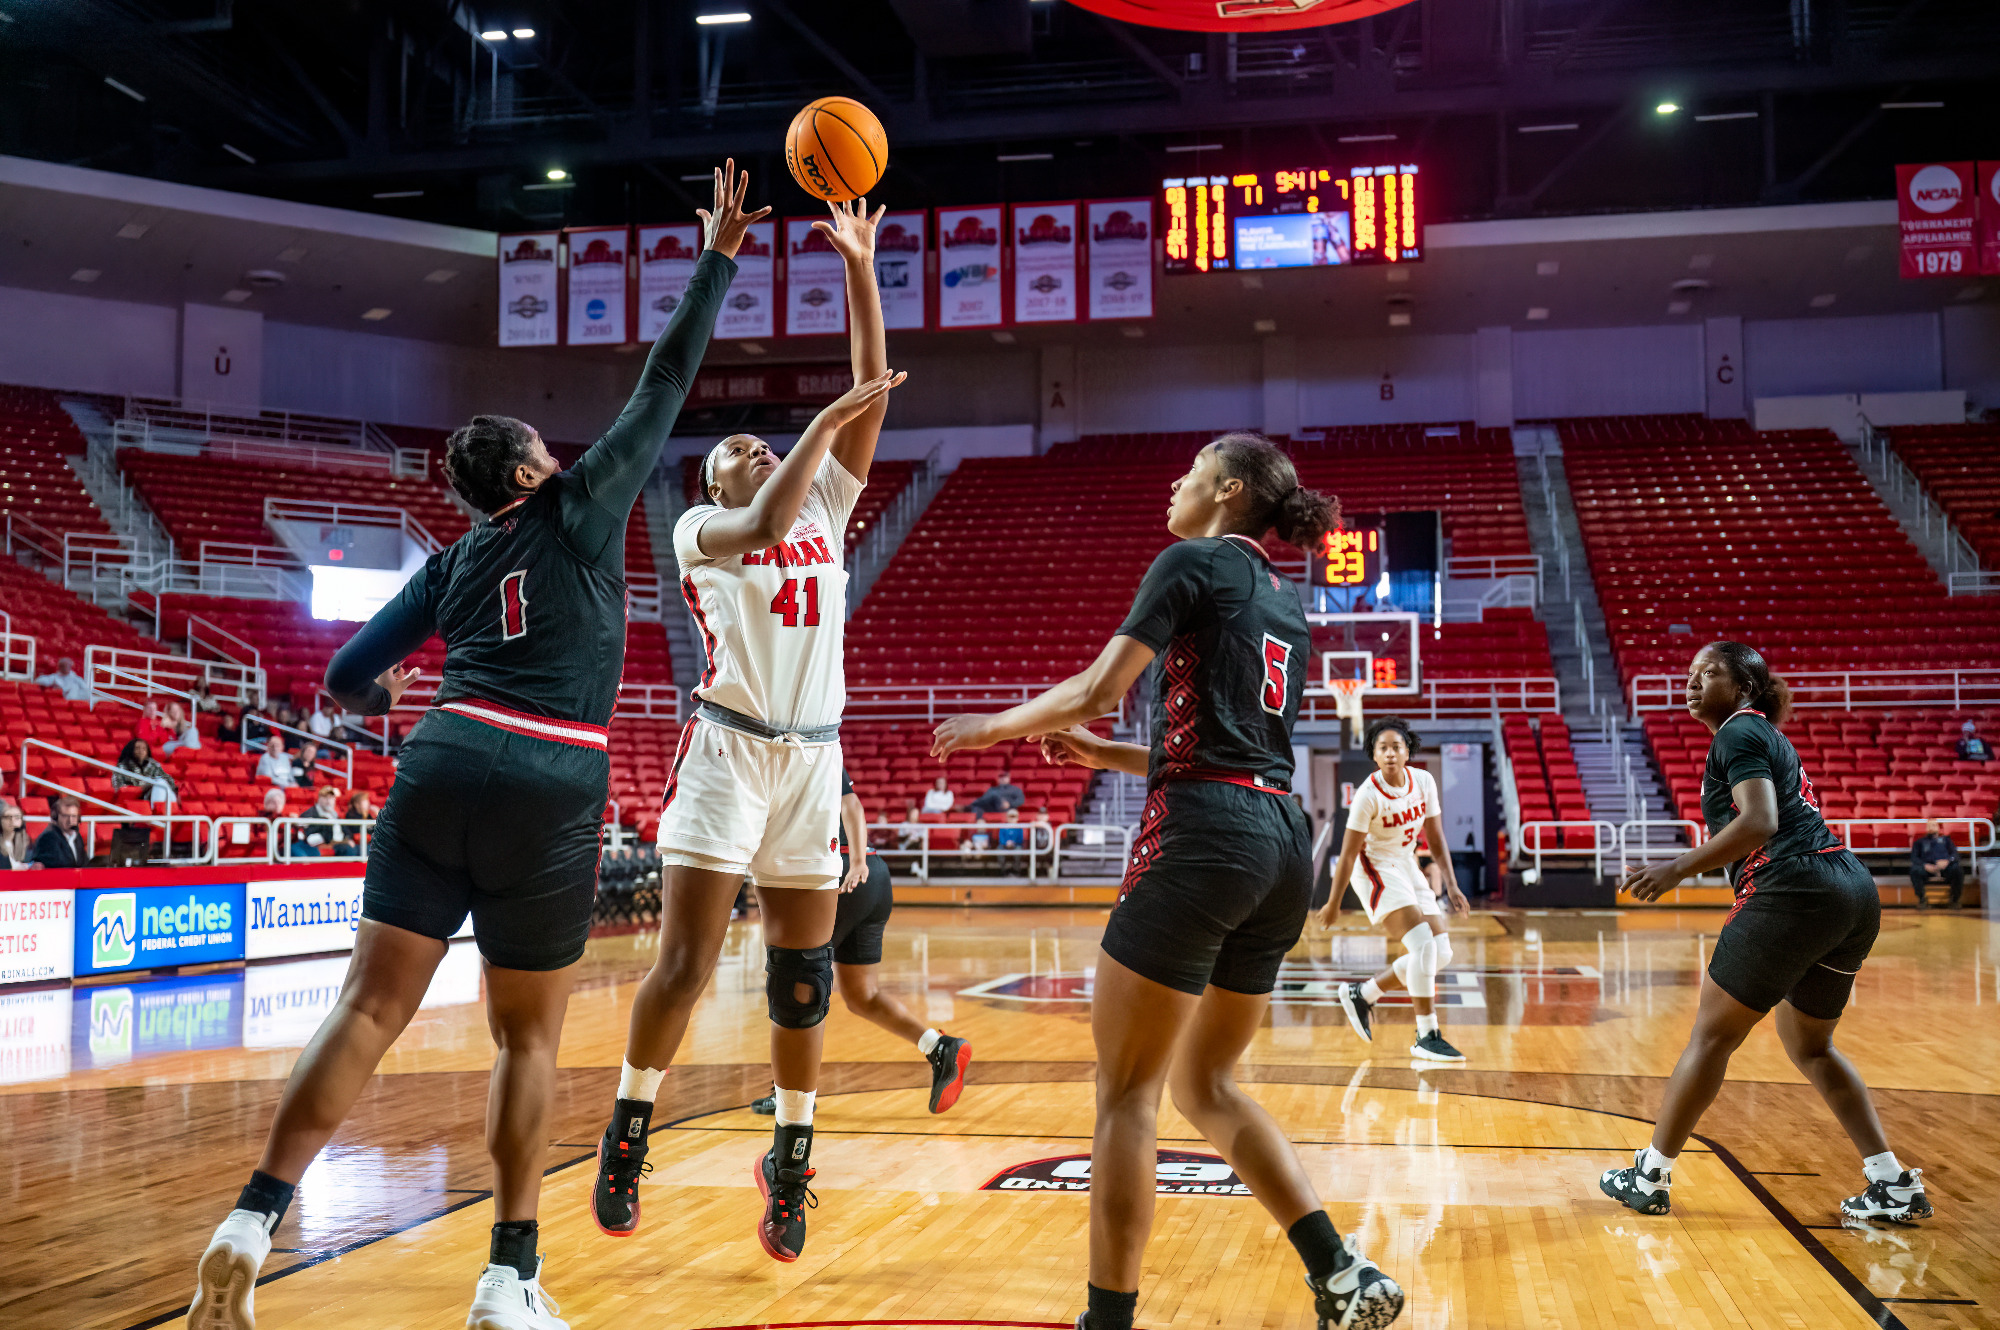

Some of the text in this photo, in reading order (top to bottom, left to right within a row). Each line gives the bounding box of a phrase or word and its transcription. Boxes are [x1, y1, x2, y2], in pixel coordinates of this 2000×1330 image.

[801, 153, 838, 195] NCAA
[1276, 171, 1316, 192] 9:41
[1245, 186, 1262, 205] 11
[1335, 180, 1348, 199] 7
[1916, 188, 1960, 201] NCAA
[1901, 217, 1973, 230] TOURNAMENT
[1903, 231, 1971, 243] APPEARANCE
[1916, 250, 1962, 274] 1979
[215, 356, 230, 376] U
[1716, 364, 1734, 385] C
[1050, 391, 1065, 408] A
[1380, 383, 1394, 400] B
[1326, 552, 1364, 583] 23
[500, 569, 529, 641] 1
[770, 576, 820, 627] 41
[1260, 632, 1292, 716] 5
[1402, 828, 1414, 847] 3
[0, 900, 71, 922] IVERSITY
[142, 895, 232, 935] neches
[251, 892, 360, 932] Manning
[142, 932, 232, 951] FEDERAL CREDIT UNION
